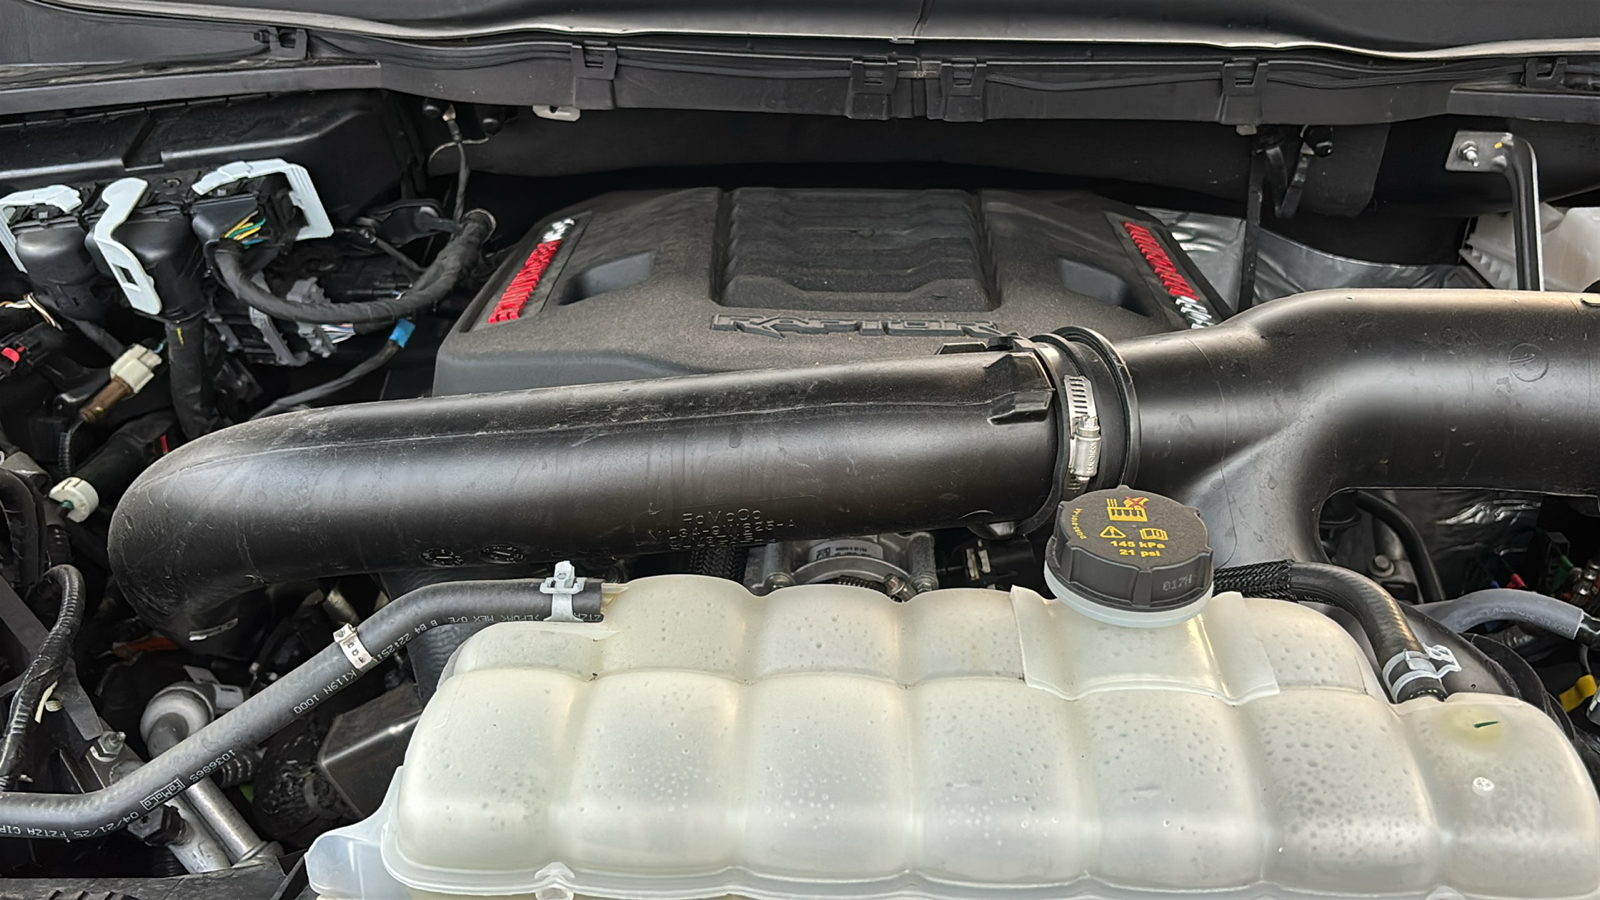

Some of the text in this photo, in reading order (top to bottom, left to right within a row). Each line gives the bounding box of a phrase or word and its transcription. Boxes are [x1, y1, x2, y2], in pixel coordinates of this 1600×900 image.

[710, 314, 1005, 340] RAPTOR
[1110, 540, 1166, 549] 145 kPa
[1140, 550, 1161, 558] psi
[473, 614, 494, 623] MEX
[323, 670, 357, 696] K119N
[293, 694, 320, 715] 1000
[188, 749, 236, 783] 1036865
[141, 779, 185, 810] FoMoCo
